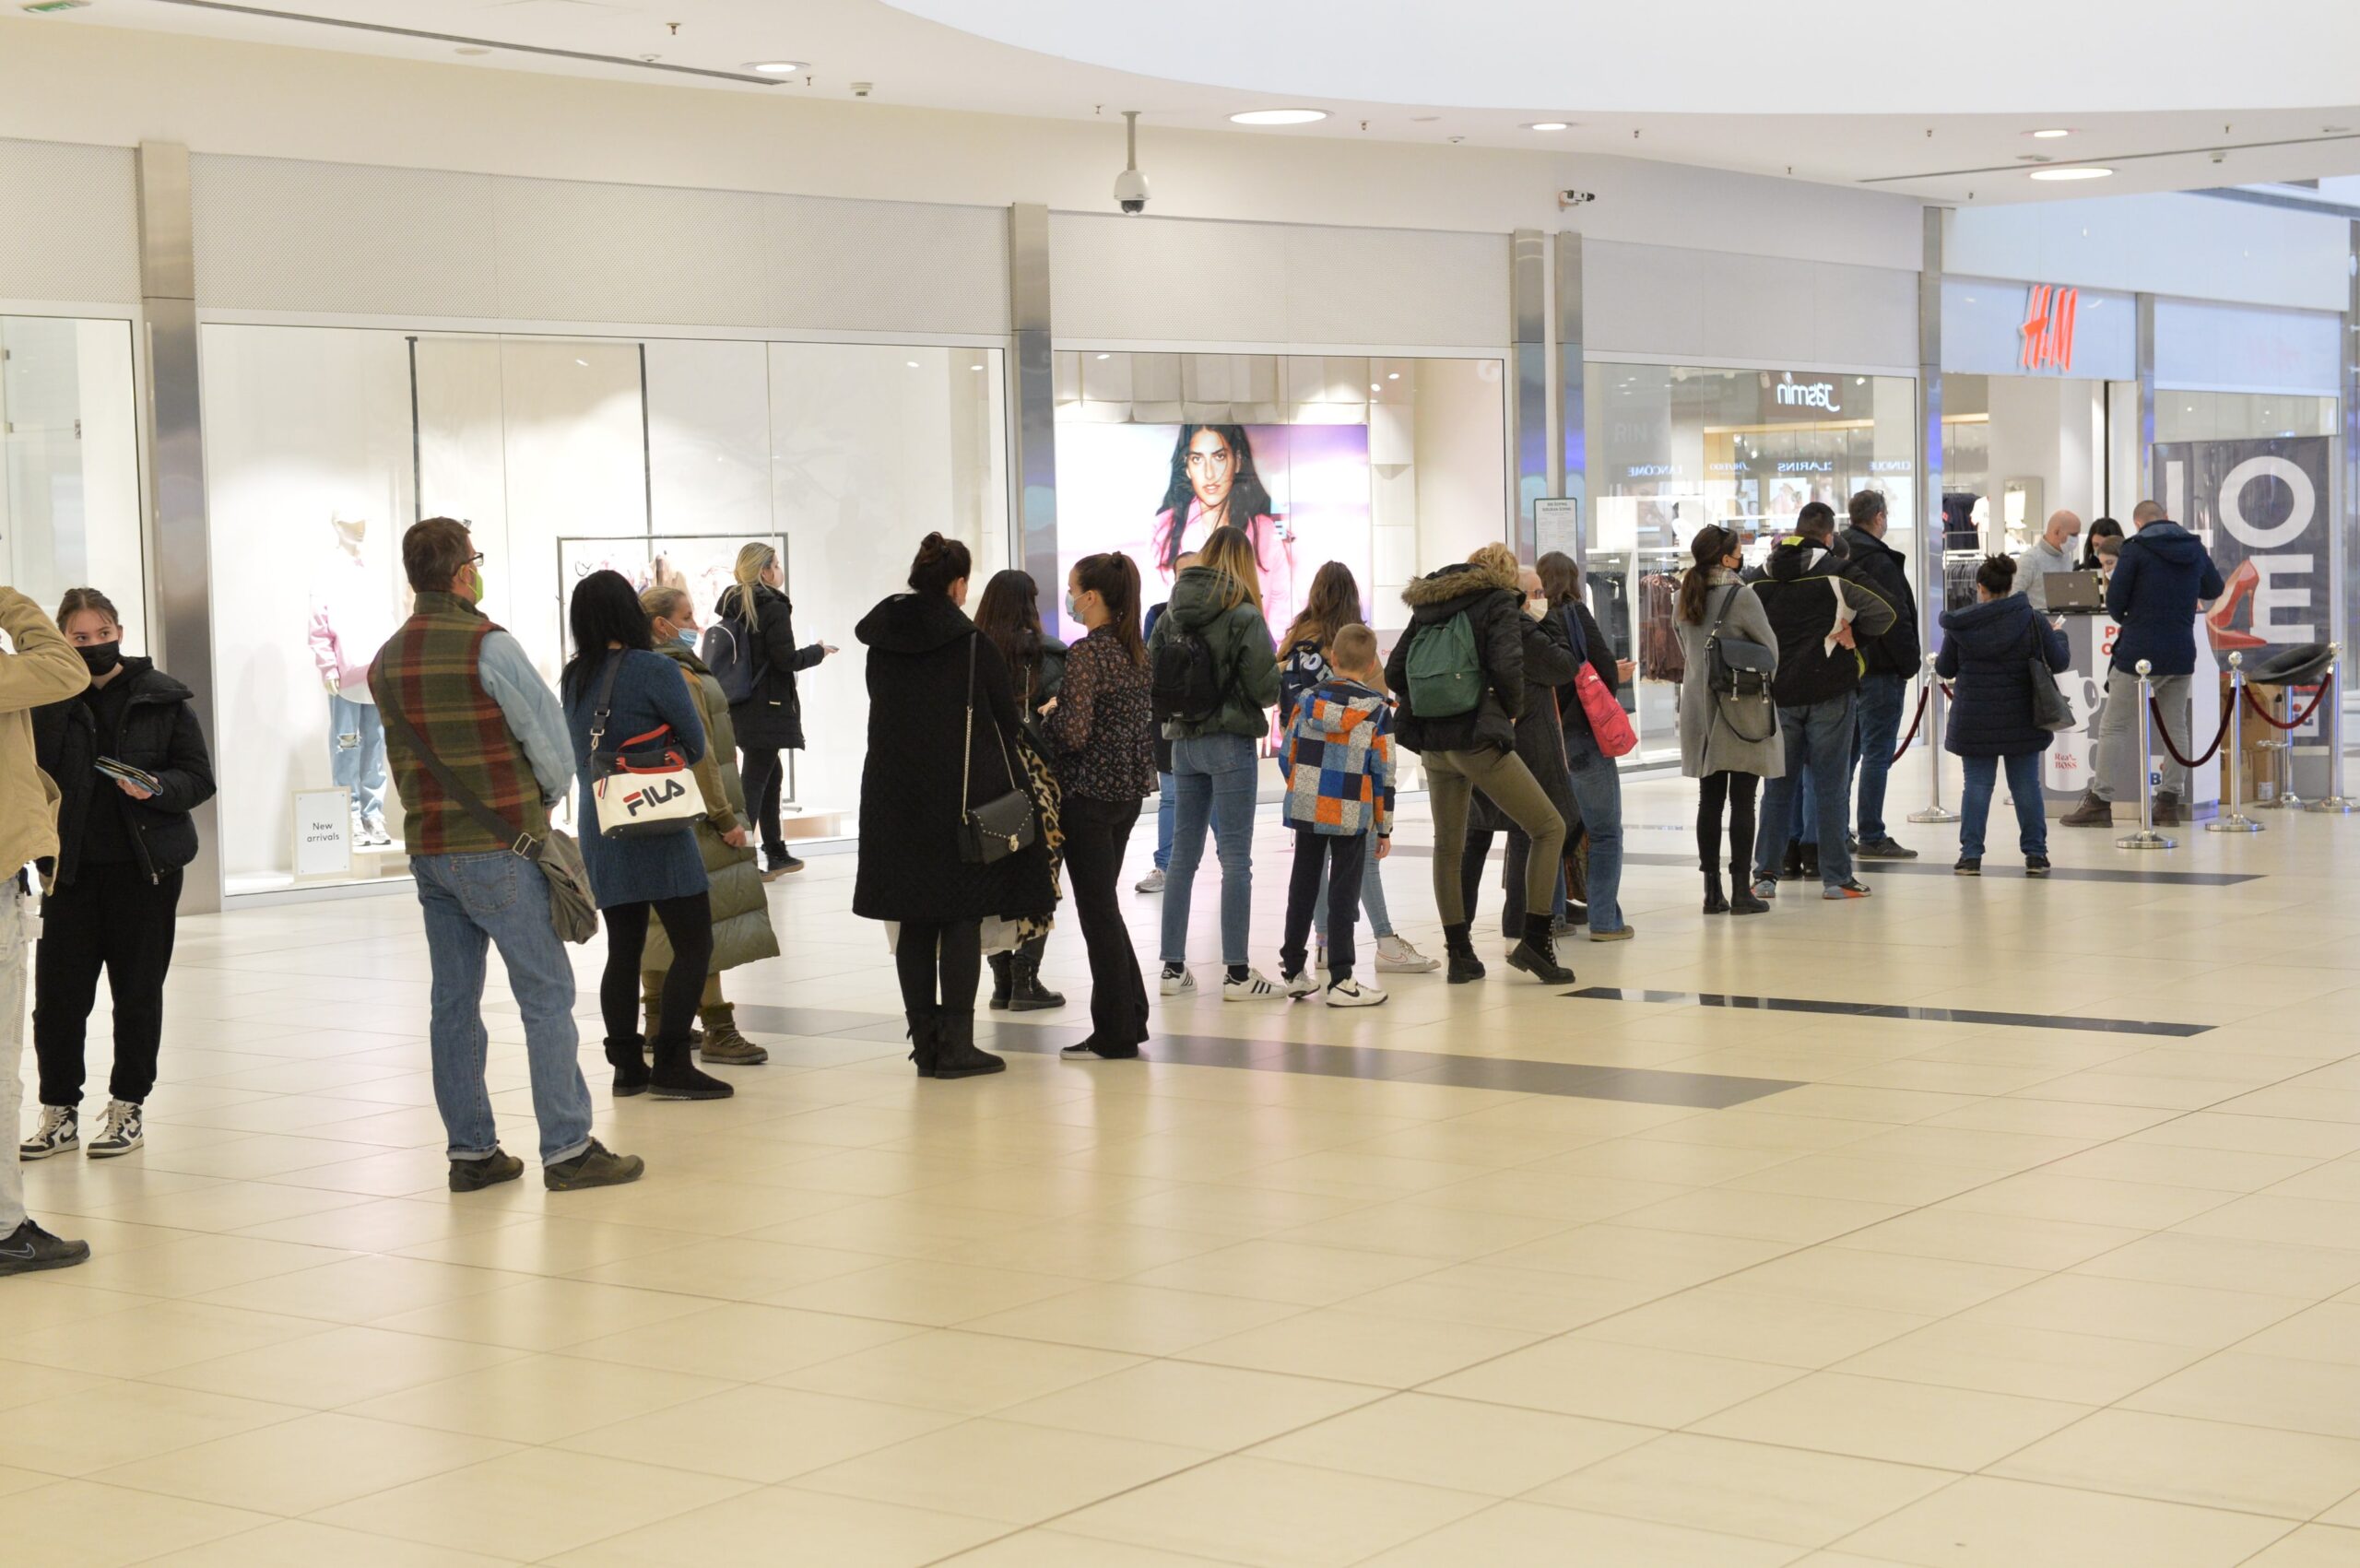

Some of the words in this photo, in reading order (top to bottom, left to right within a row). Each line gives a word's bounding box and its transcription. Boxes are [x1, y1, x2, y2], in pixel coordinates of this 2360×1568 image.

[2023, 284, 2079, 371] H&M
[623, 779, 685, 817] FILA
[306, 832, 339, 843] arrivals
[313, 822, 333, 831] New
